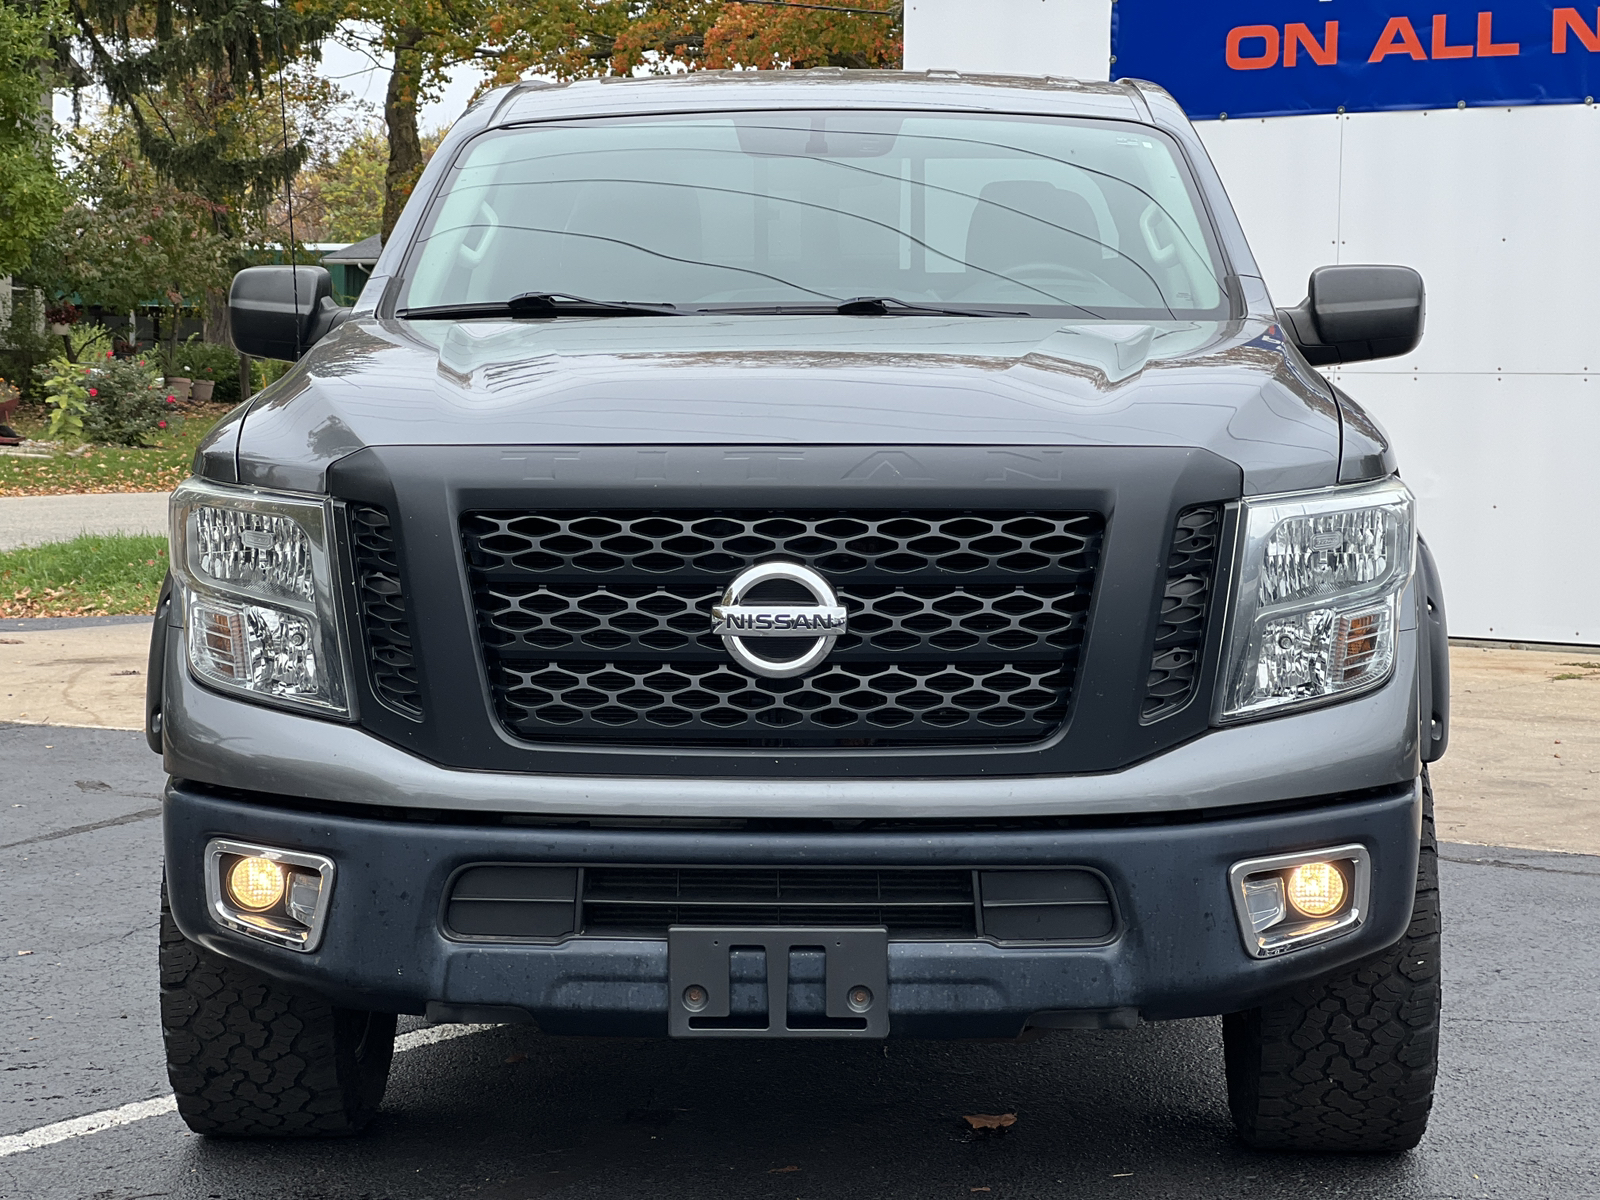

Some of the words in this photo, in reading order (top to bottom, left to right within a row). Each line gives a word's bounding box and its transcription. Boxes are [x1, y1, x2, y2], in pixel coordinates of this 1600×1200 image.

[1225, 20, 1339, 71] ON
[1367, 11, 1520, 63] ALL
[500, 449, 1063, 482] TITAN
[725, 613, 832, 630] NISSAN
